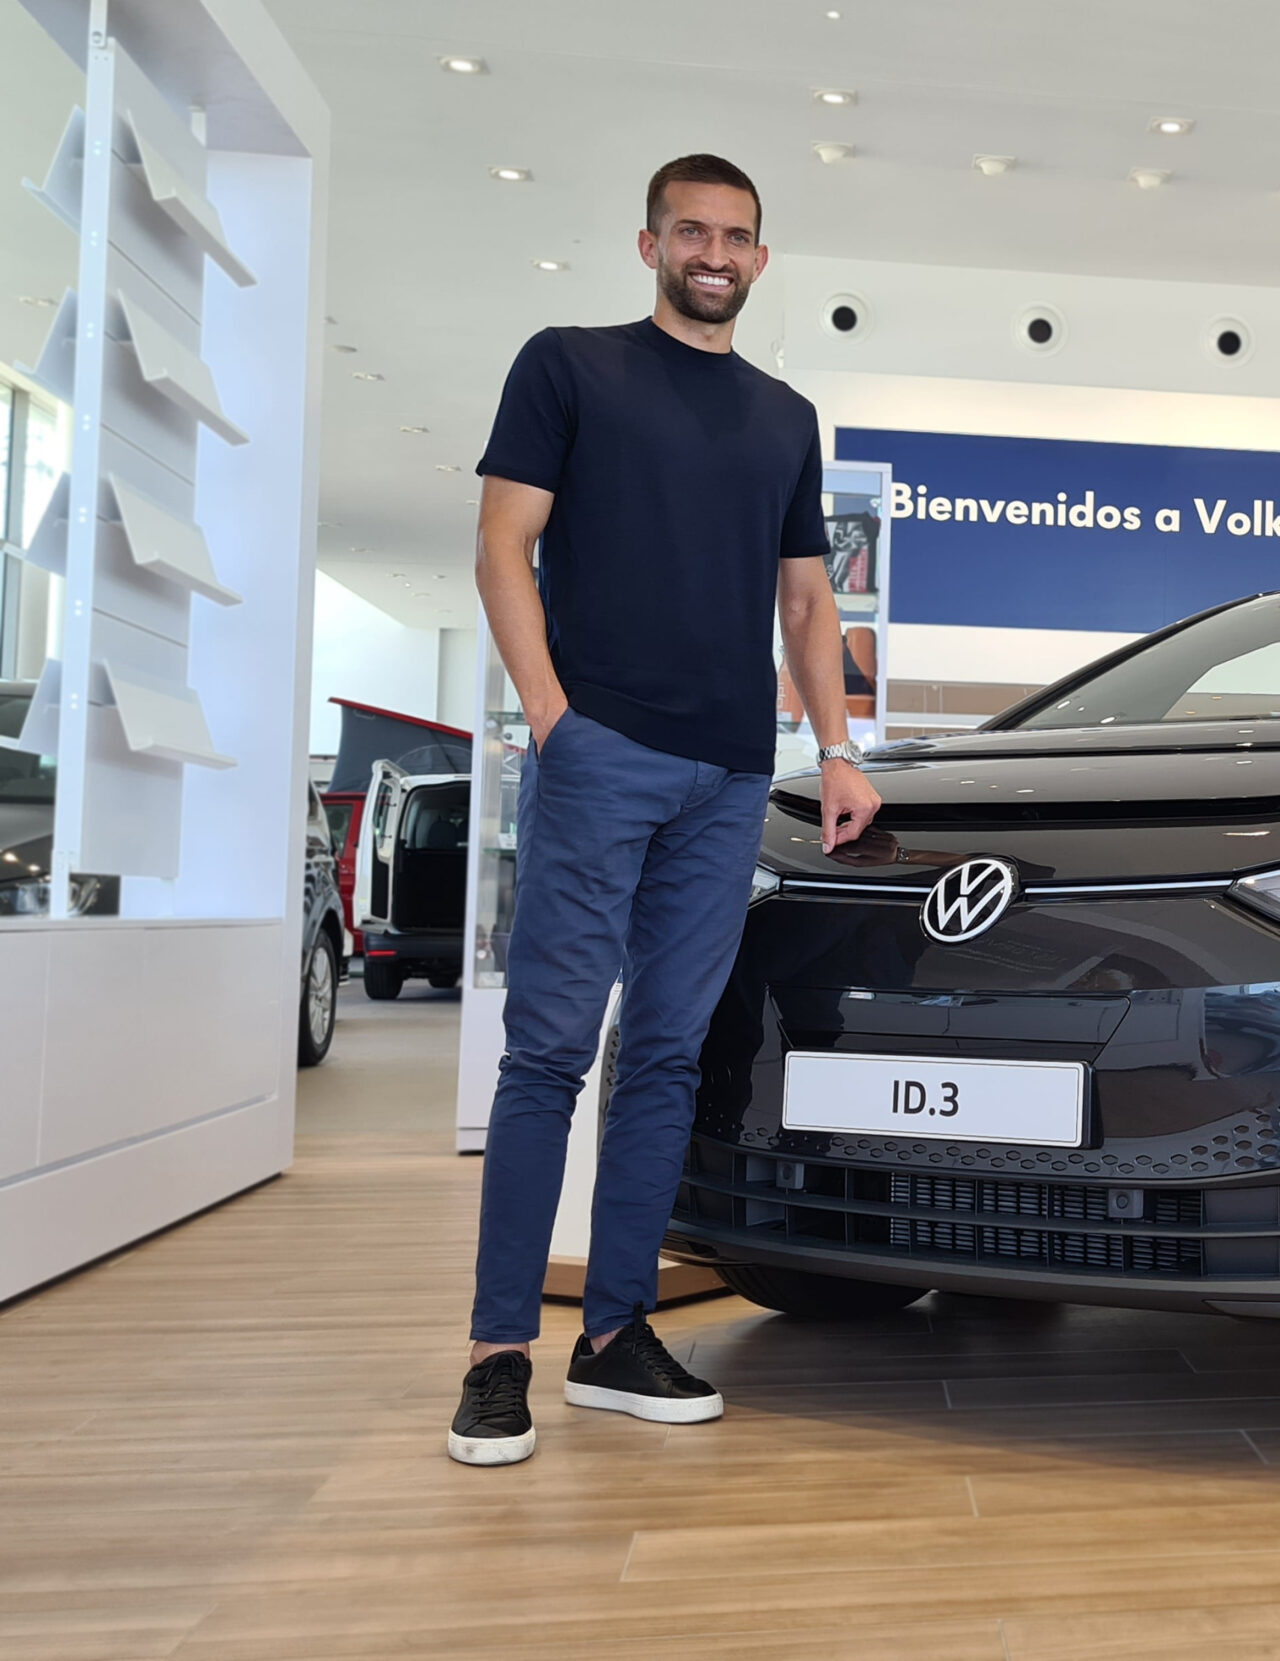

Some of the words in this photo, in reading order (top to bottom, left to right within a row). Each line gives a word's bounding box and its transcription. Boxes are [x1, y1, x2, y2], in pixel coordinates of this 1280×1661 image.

[891, 482, 1141, 530] Bienvenidos
[1156, 508, 1180, 533] a
[892, 1079, 959, 1117] ID.3
